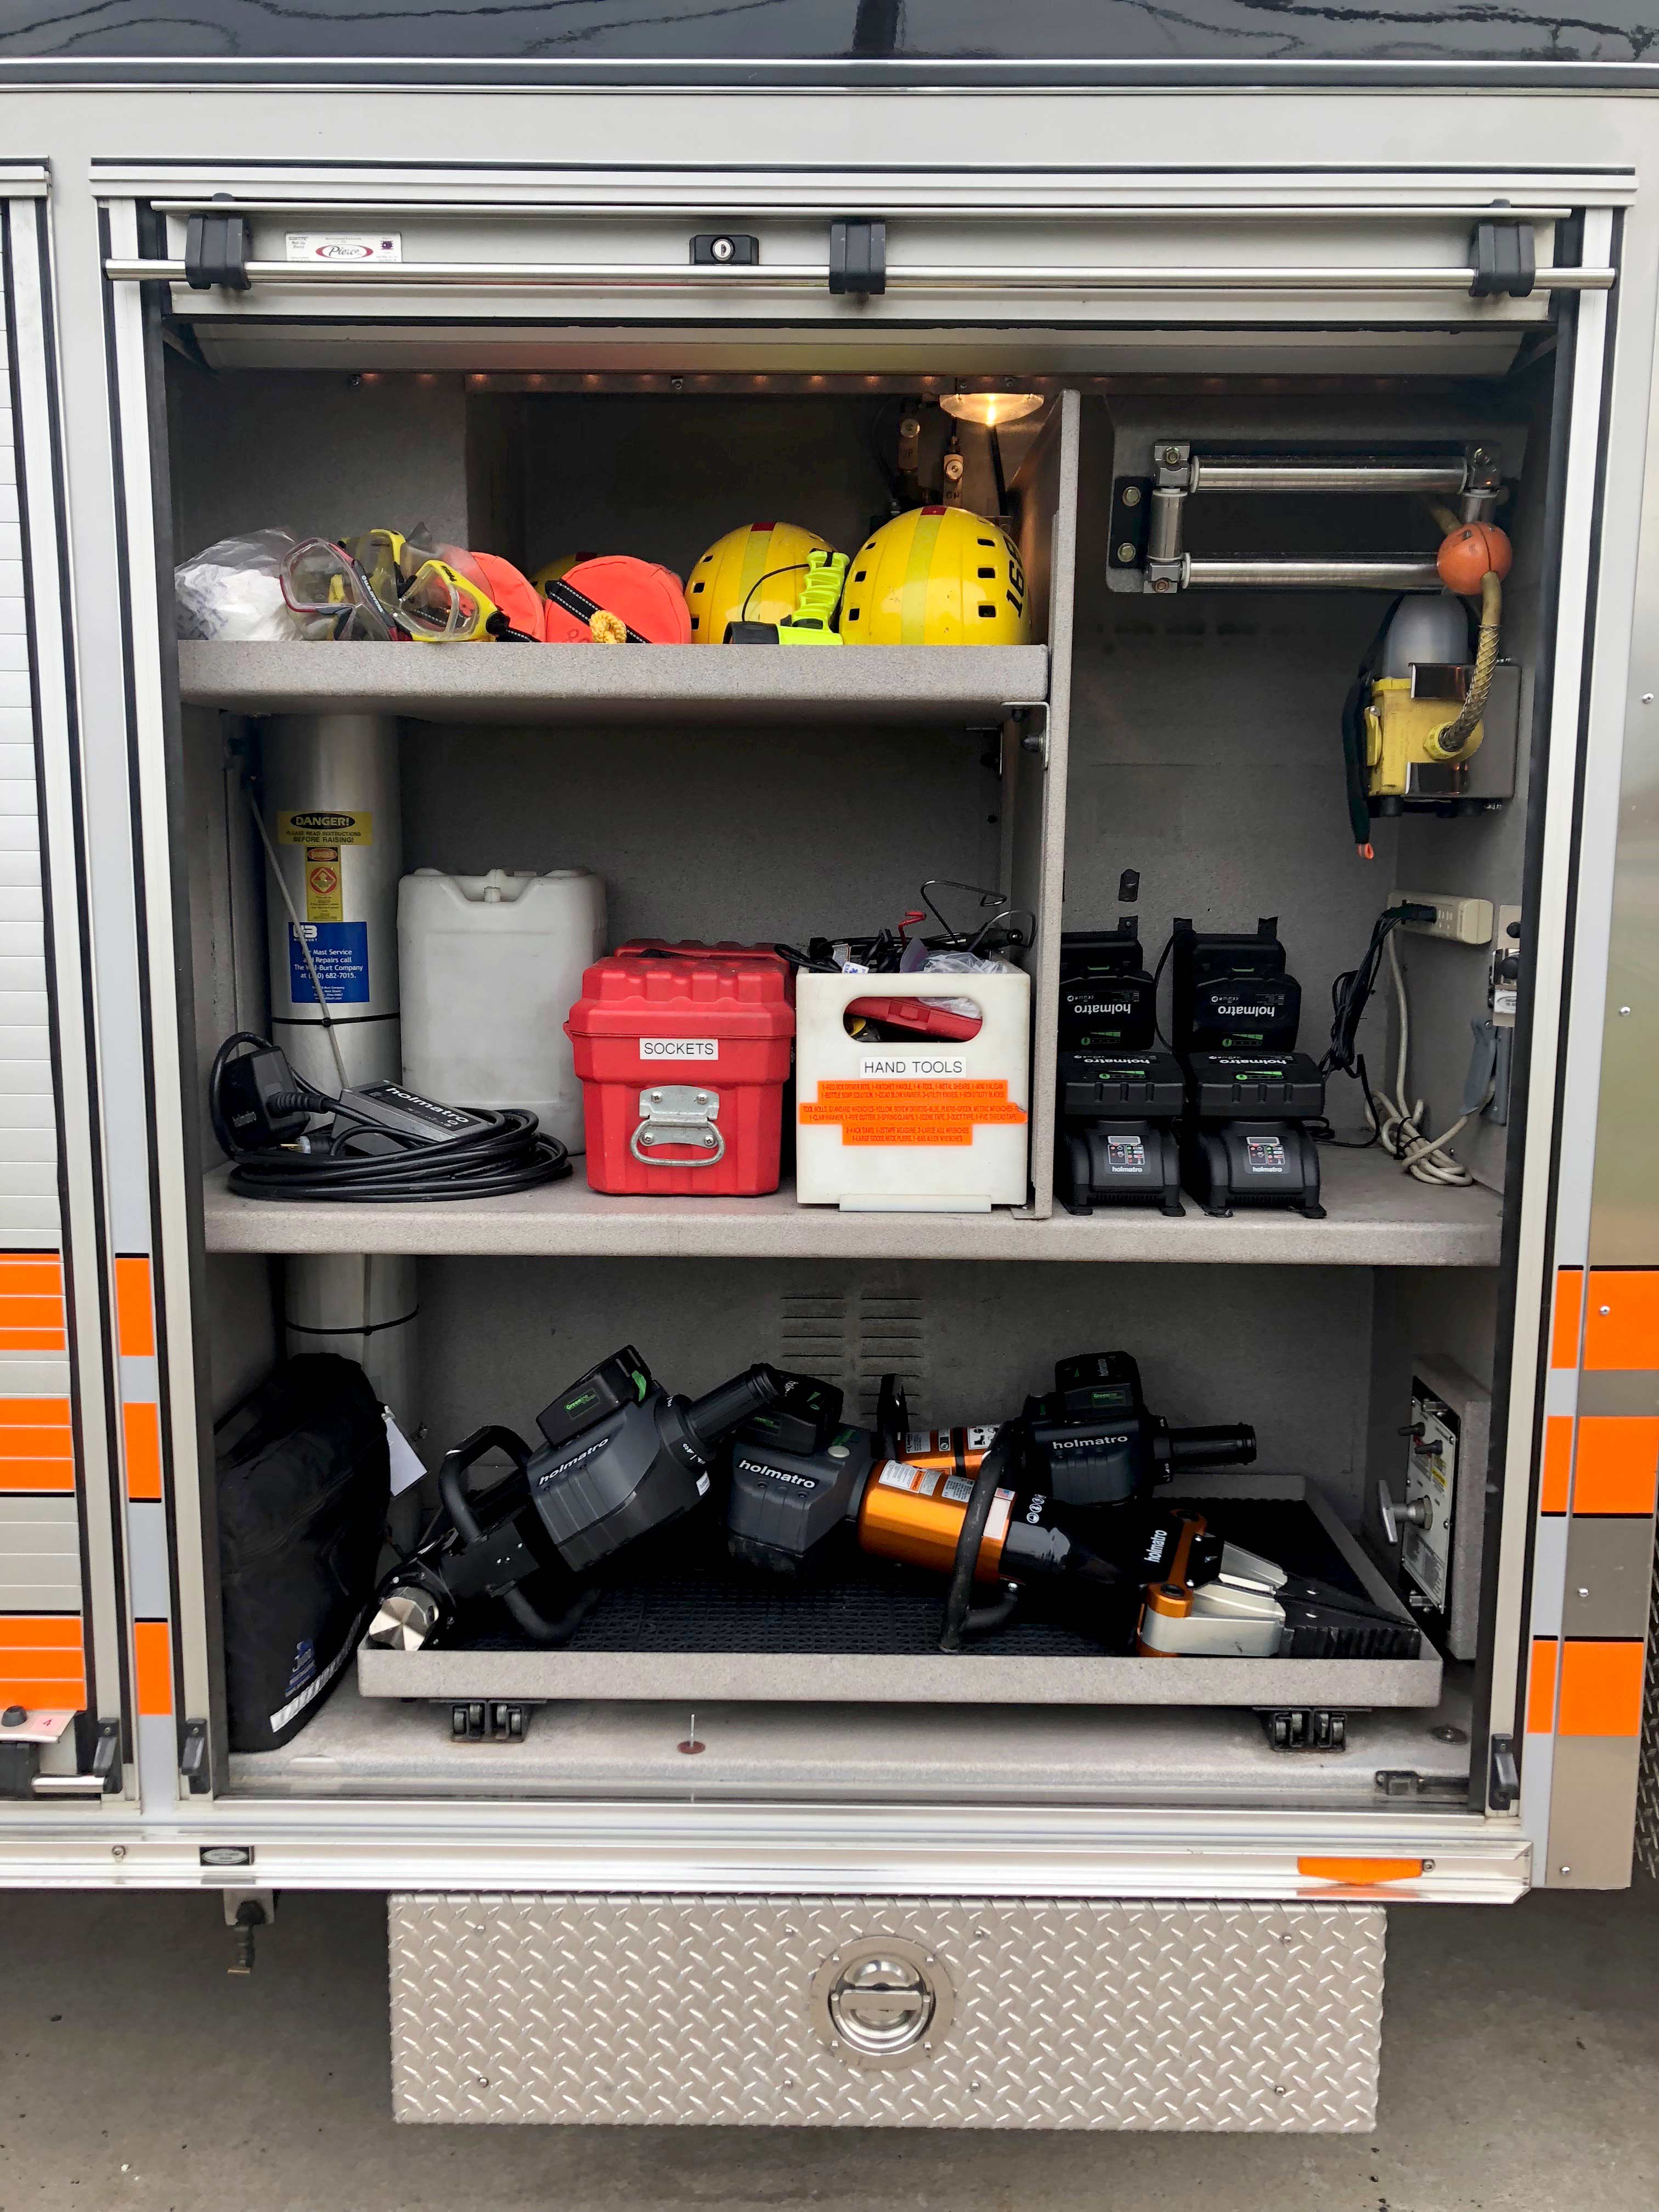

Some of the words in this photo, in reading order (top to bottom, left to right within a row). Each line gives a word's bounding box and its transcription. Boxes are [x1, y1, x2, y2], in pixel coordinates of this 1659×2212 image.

[329, 246, 360, 256] Pierce
[296, 817, 349, 826] DANGER!
[1074, 1003, 1131, 1014] holmatro
[1218, 1006, 1275, 1017] holmatro
[644, 1042, 714, 1055] SOCKETS
[864, 1061, 906, 1073] HAND
[912, 1060, 963, 1073] TOOLS
[385, 1087, 469, 1123] holmatro
[1053, 1435, 1128, 1449] holmatro
[538, 1438, 610, 1486] holmatro
[738, 1459, 816, 1489] holmatro
[1144, 1530, 1167, 1563] holmatro
